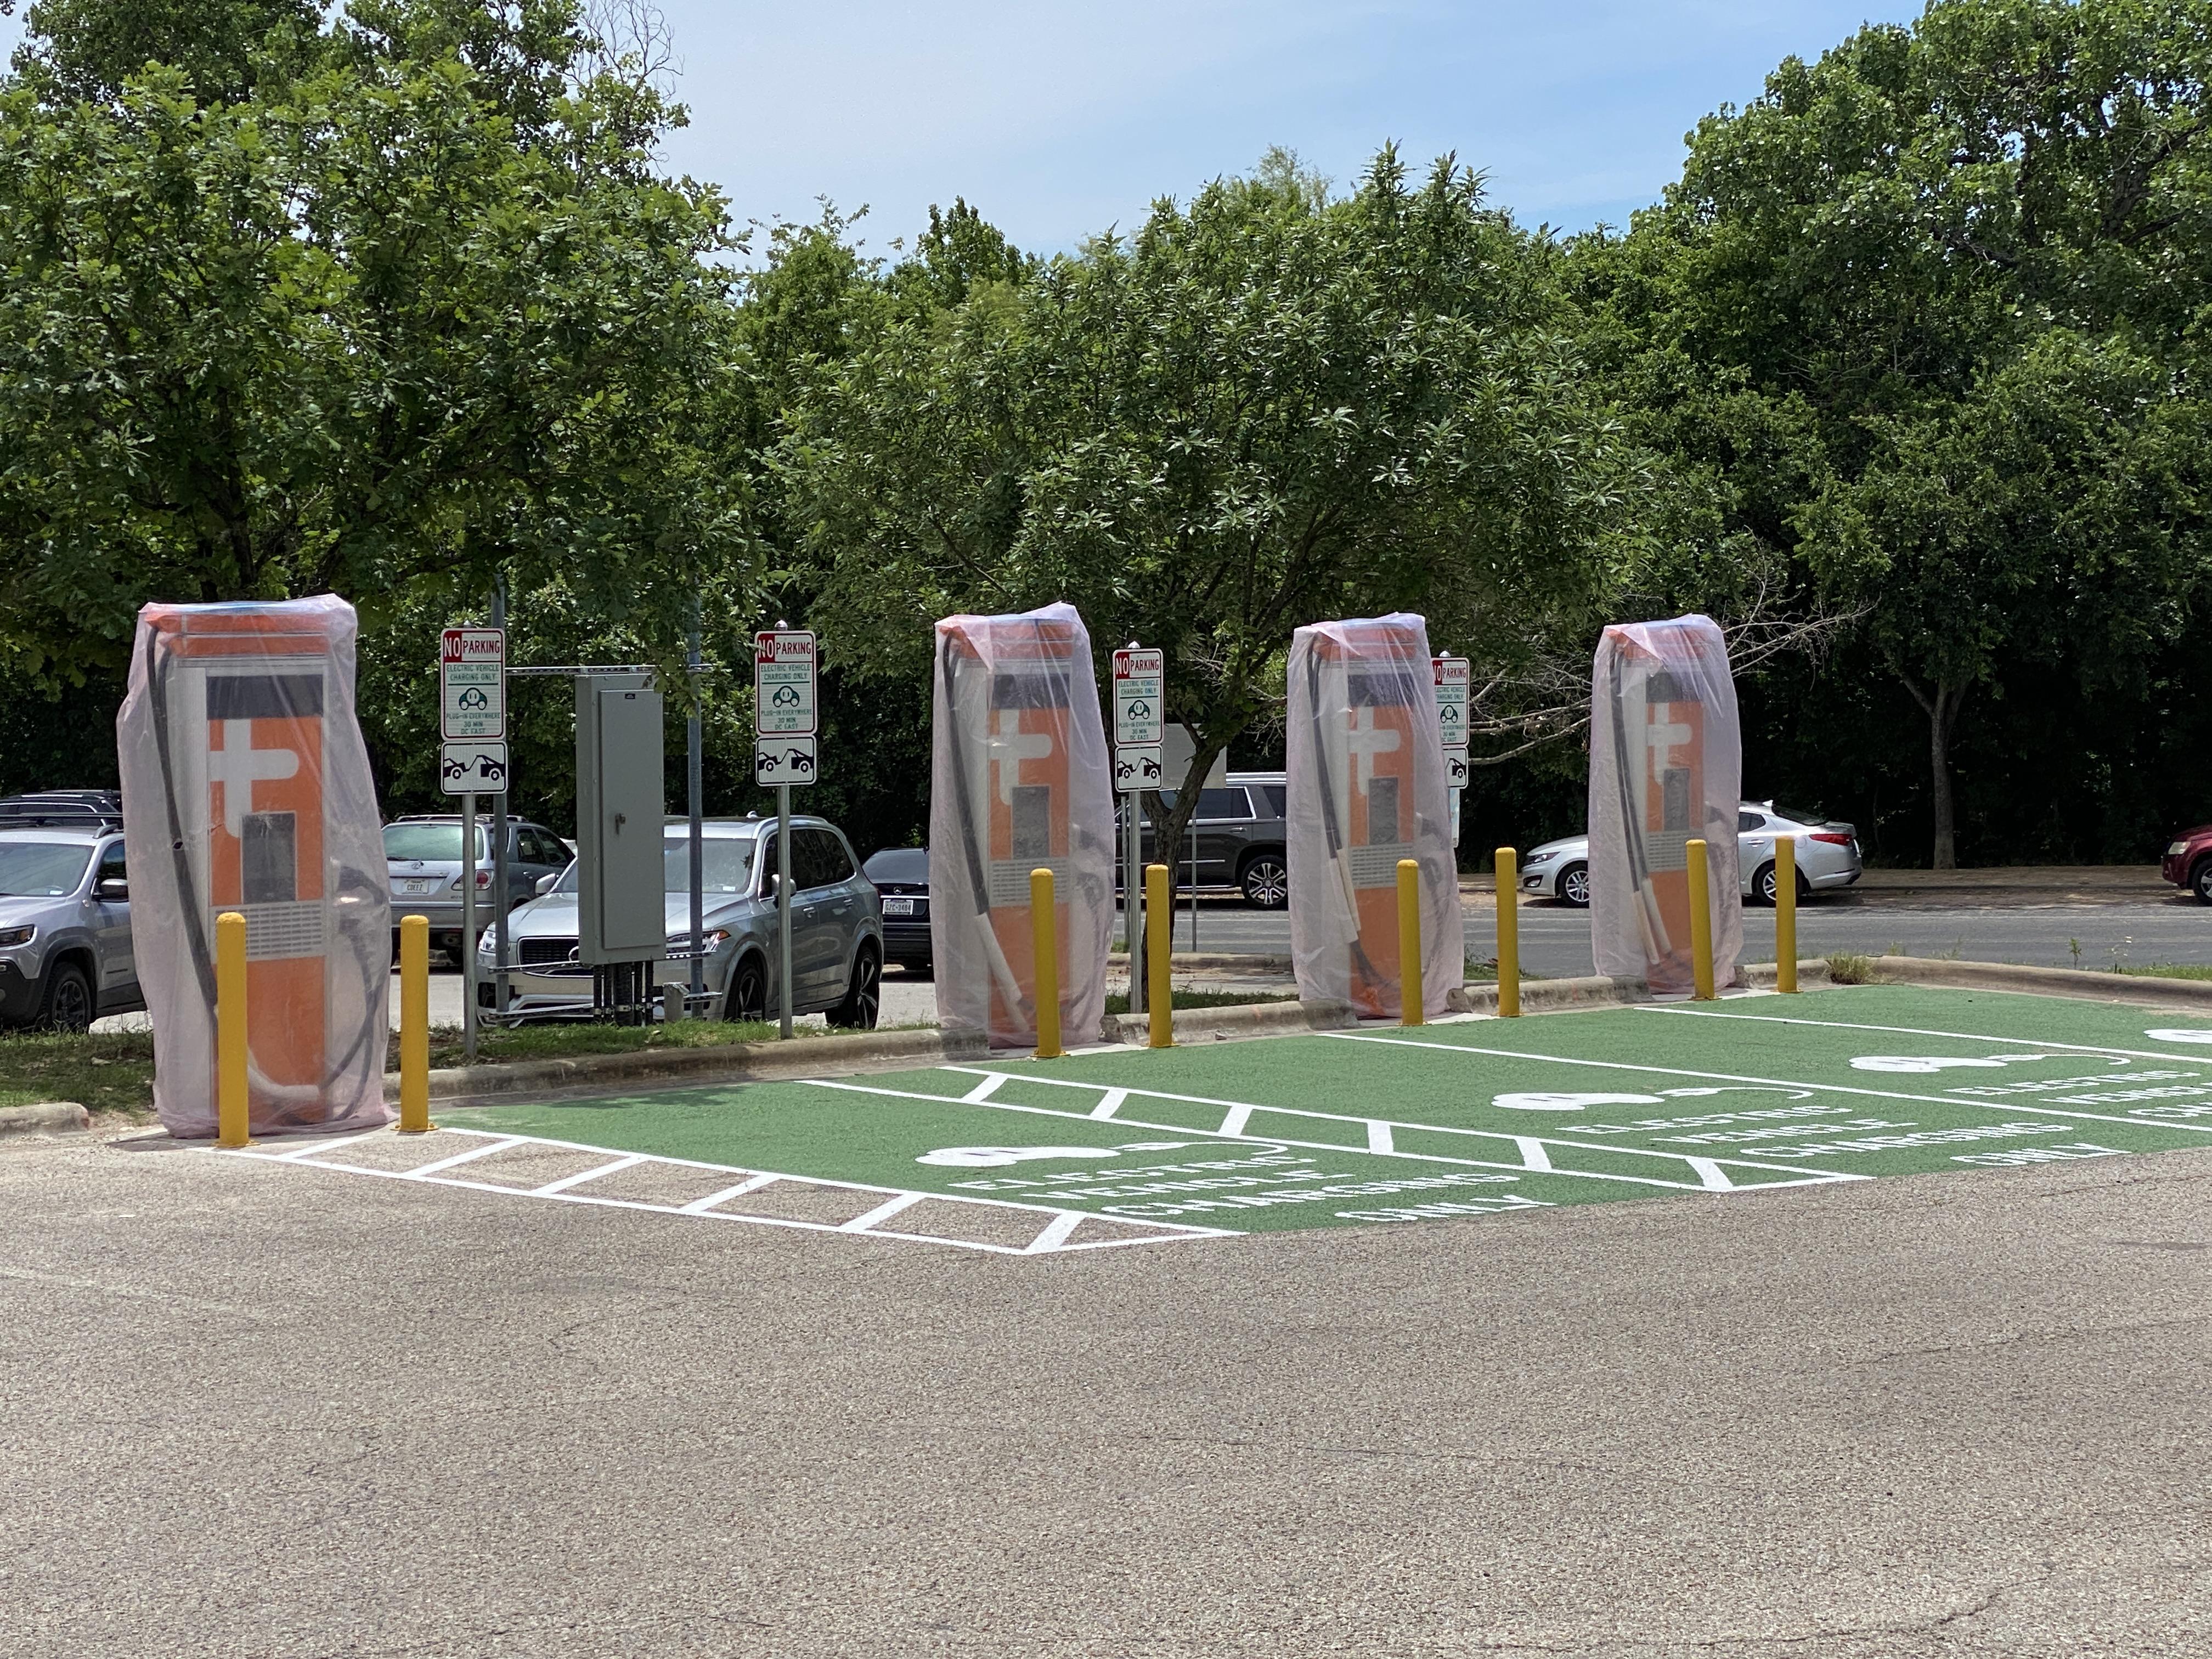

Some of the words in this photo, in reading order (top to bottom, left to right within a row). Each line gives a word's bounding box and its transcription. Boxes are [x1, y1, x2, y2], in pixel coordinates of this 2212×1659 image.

[444, 637, 461, 657] NO
[463, 640, 500, 653] PARKING
[758, 639, 774, 658] NO
[776, 642, 811, 654] PARKING
[1116, 657, 1129, 675] NO
[1130, 659, 1159, 672] PARKING
[1443, 667, 1466, 678] PARKING
[1555, 1105, 1853, 1134] ELECTRIC
[1650, 1119, 1918, 1144] VEHICLE
[1740, 1122, 2073, 1157] CHARGING
[1950, 1143, 2132, 1166] ONLY
[947, 1156, 1317, 1190] ELECTRIC
[1020, 1170, 1356, 1200] VEHICLE
[1101, 1173, 1520, 1216] CHARGING
[1334, 1195, 1558, 1222] ONLY
